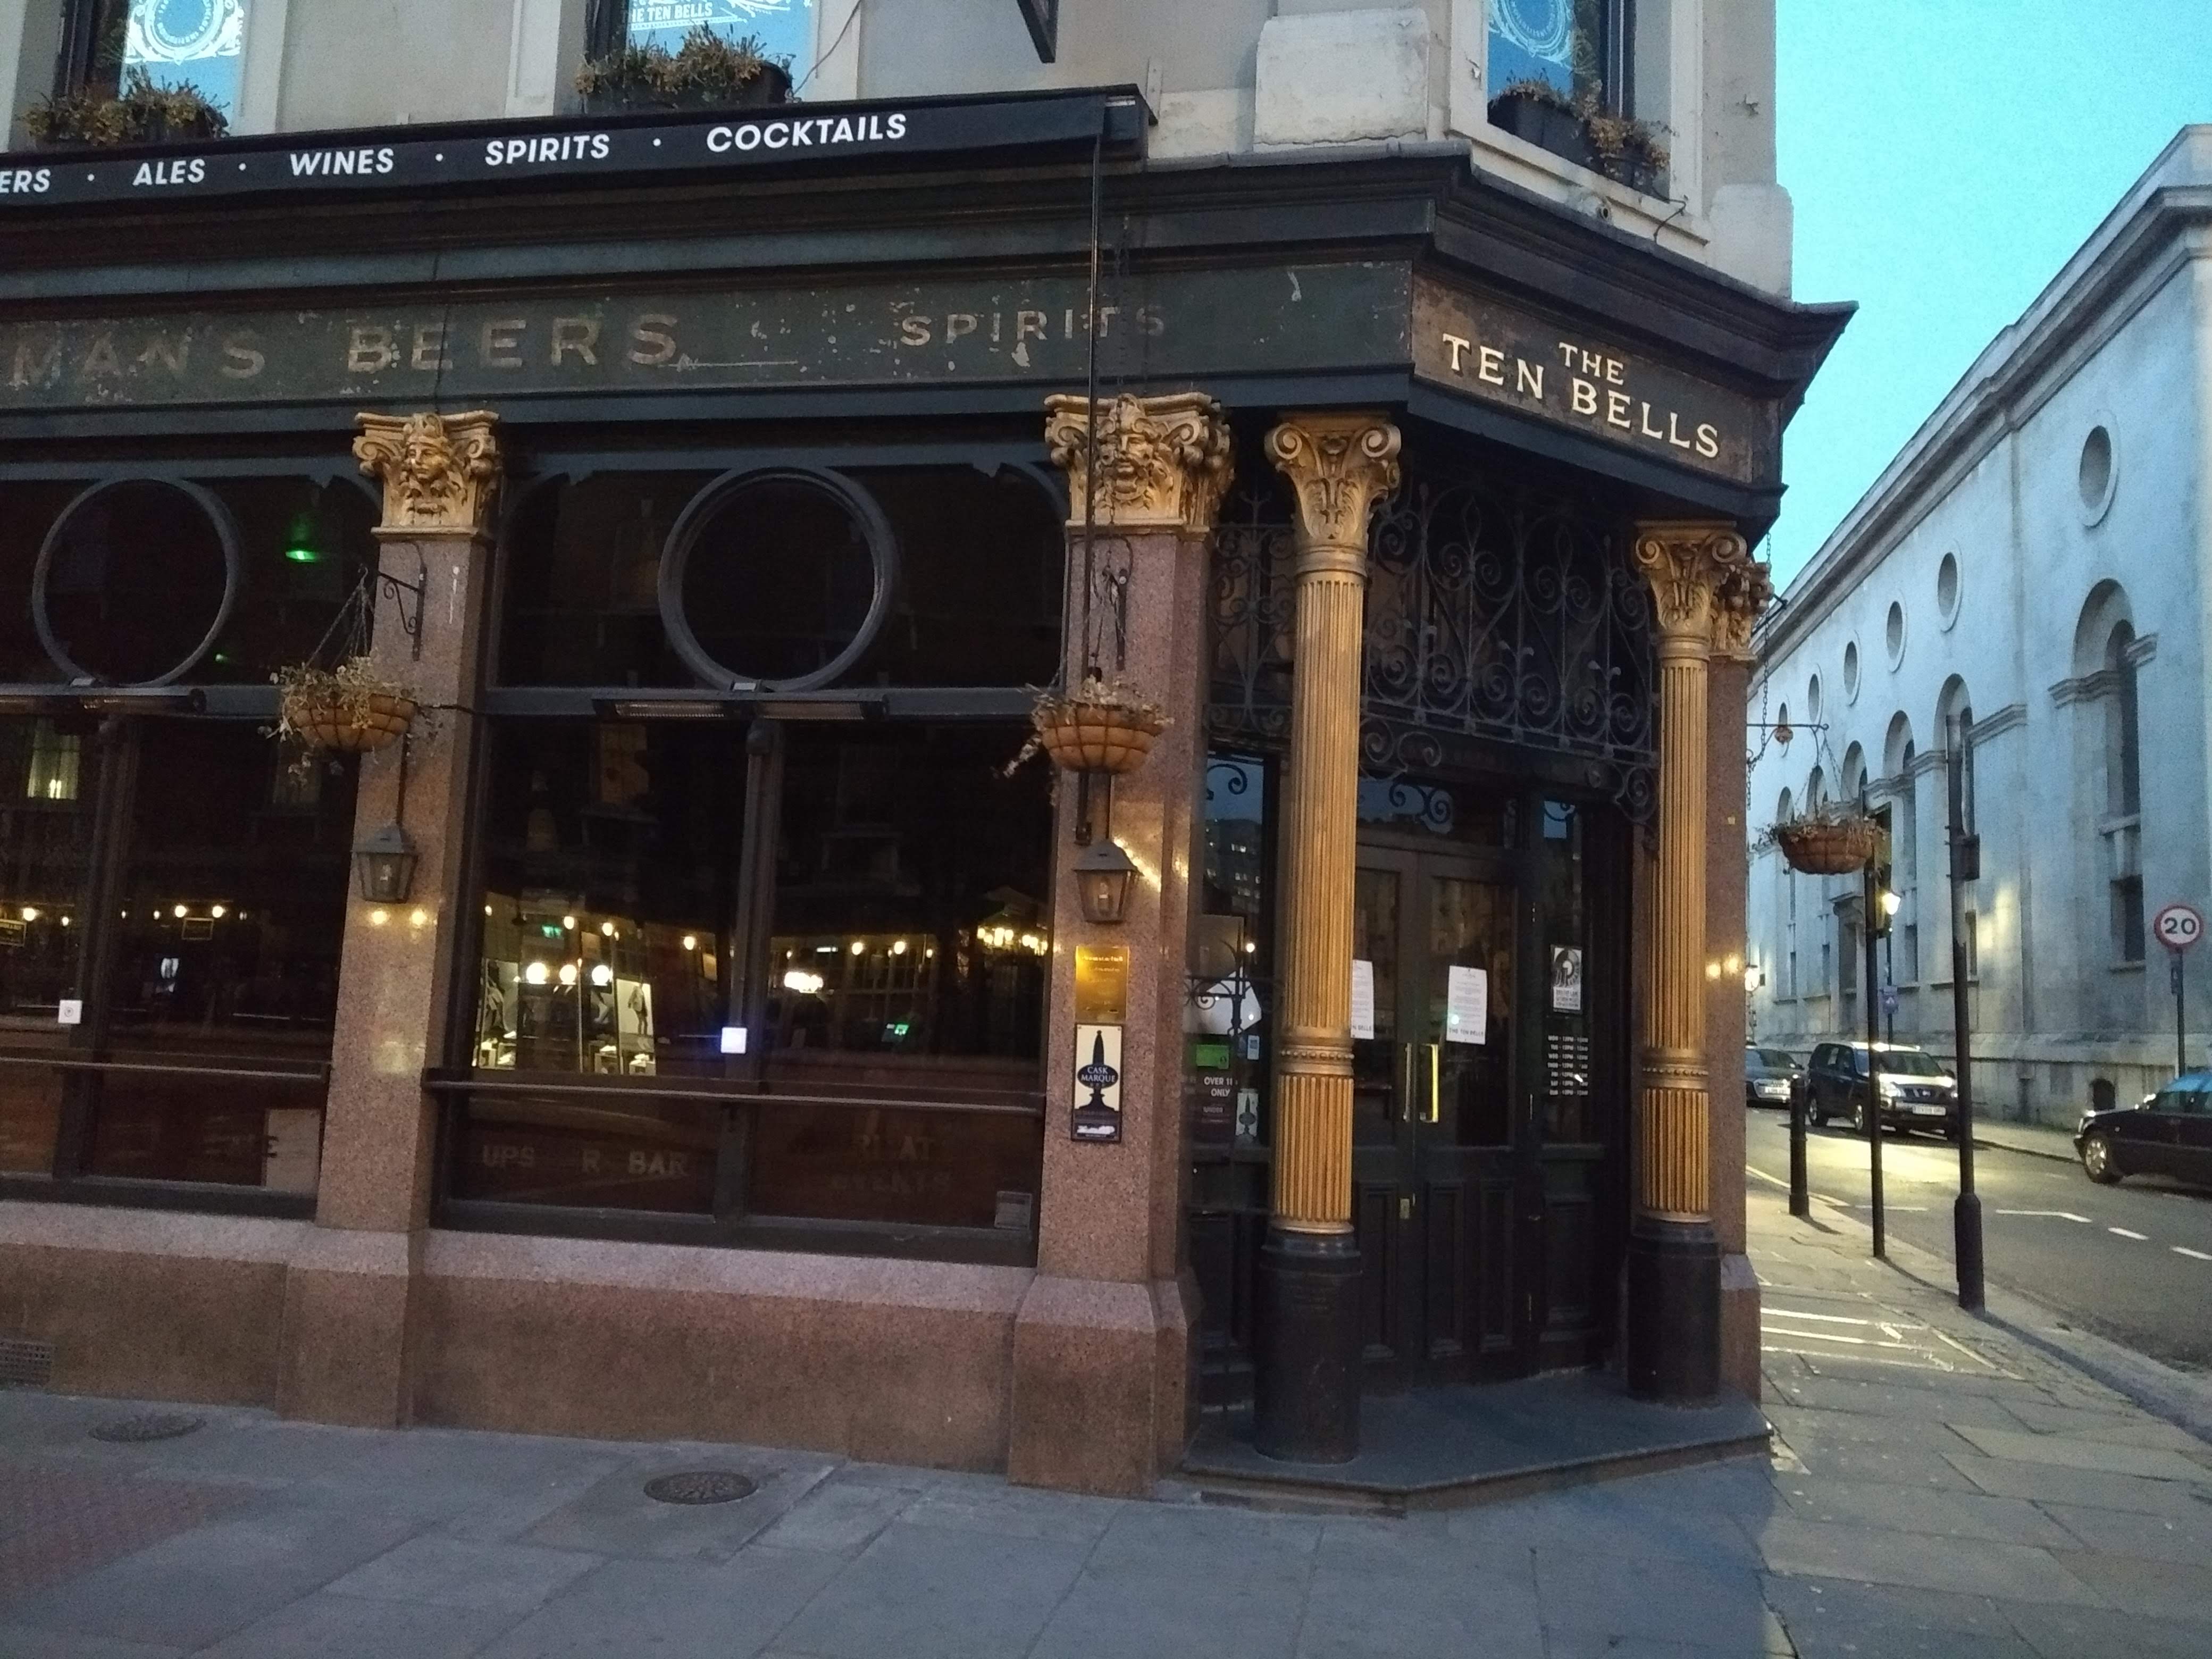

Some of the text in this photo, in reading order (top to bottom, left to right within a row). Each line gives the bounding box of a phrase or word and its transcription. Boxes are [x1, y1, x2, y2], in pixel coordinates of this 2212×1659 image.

[647, 6, 671, 22] TEN
[674, 2, 713, 19] BELLS
[0, 113, 907, 194] ERS ALES WINES SPIRITS COCKTAILS
[348, 315, 677, 372] BEERS
[1559, 342, 1624, 386] THE
[1442, 333, 1719, 459] TEN BELLS
[2164, 917, 2197, 935] 20
[1081, 1074, 1116, 1083] MARQUE
[1087, 1066, 1108, 1075] CASK
[1204, 1076, 1224, 1085] OVER
[1211, 1087, 1230, 1097] ONLY
